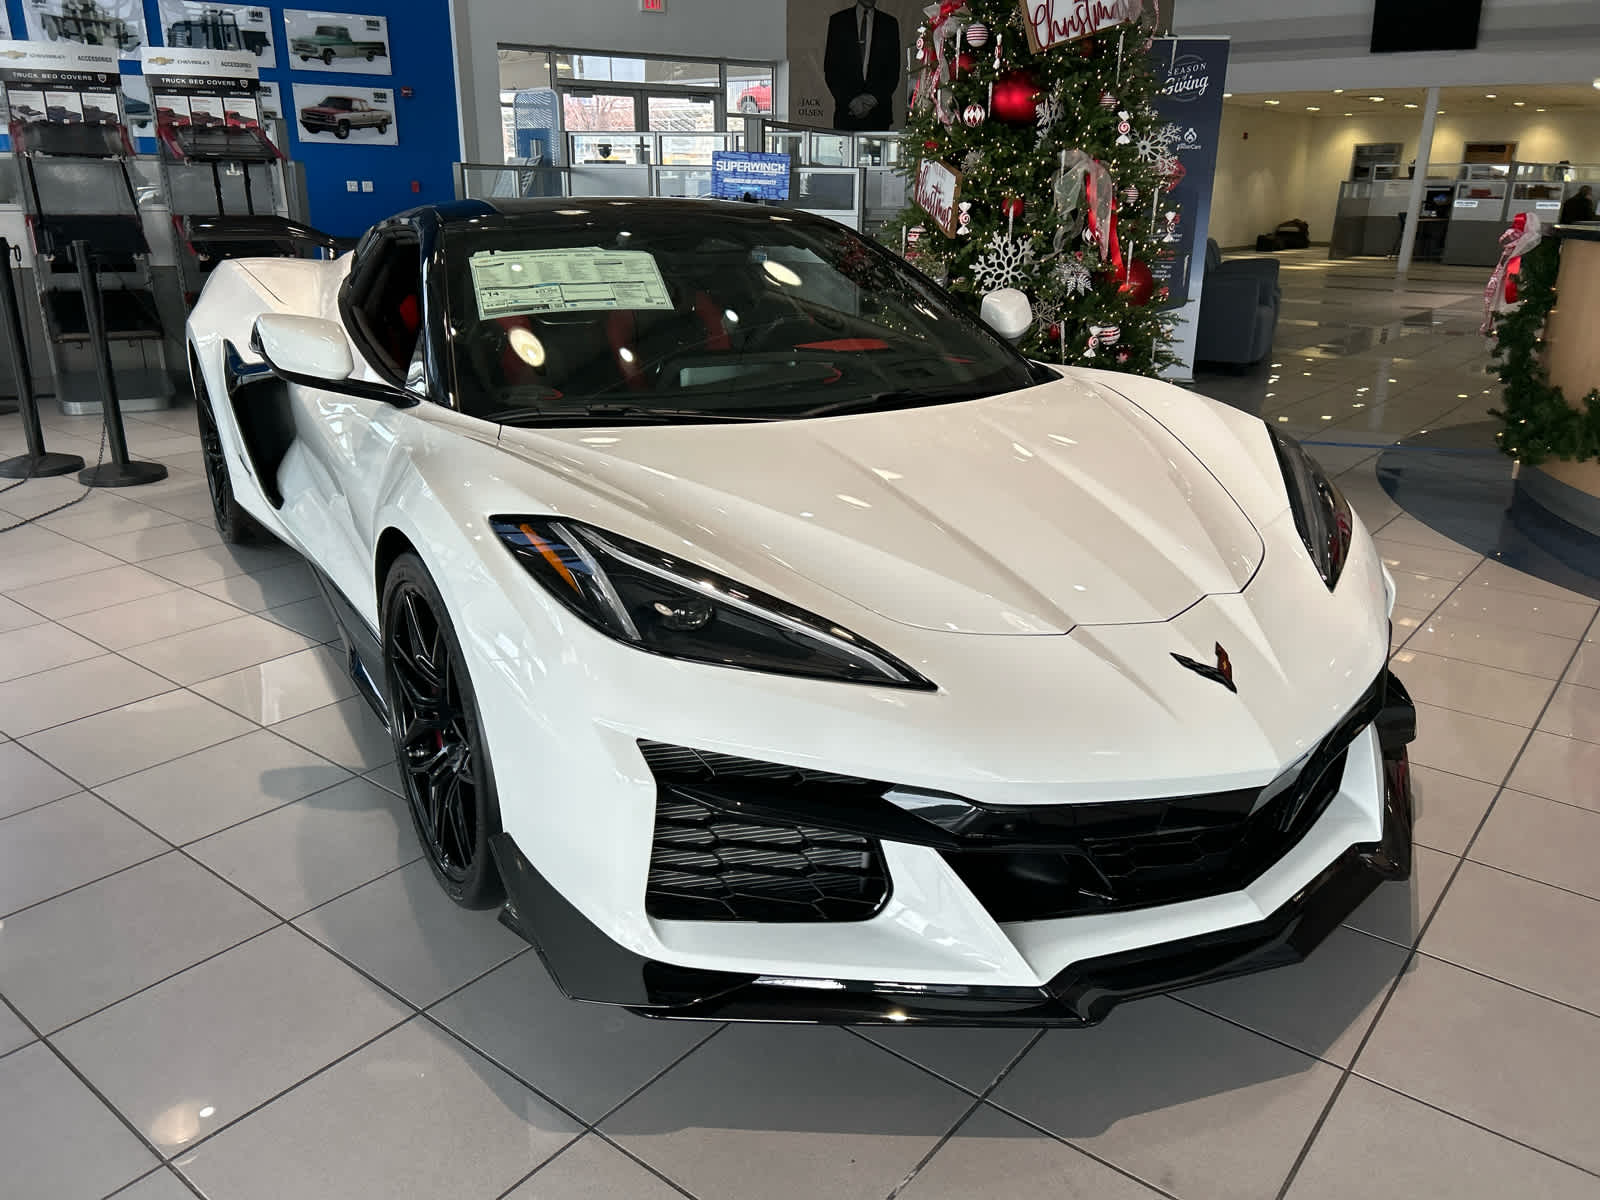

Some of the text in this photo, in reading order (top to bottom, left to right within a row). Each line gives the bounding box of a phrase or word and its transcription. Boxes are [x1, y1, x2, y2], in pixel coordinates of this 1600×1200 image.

[1027, 0, 1142, 49] Christma
[77, 55, 113, 63] ACCESSORIES
[221, 61, 252, 69] ACCESSORIES
[1167, 62, 1208, 77] SEASON
[12, 71, 39, 79] TRUCK
[161, 77, 187, 85] TRUCK
[206, 79, 237, 87] COVERS
[1164, 75, 1209, 96] Giving
[800, 98, 820, 107] JACK
[798, 109, 824, 117] OLSEN
[716, 160, 785, 174] SUPERWINCH
